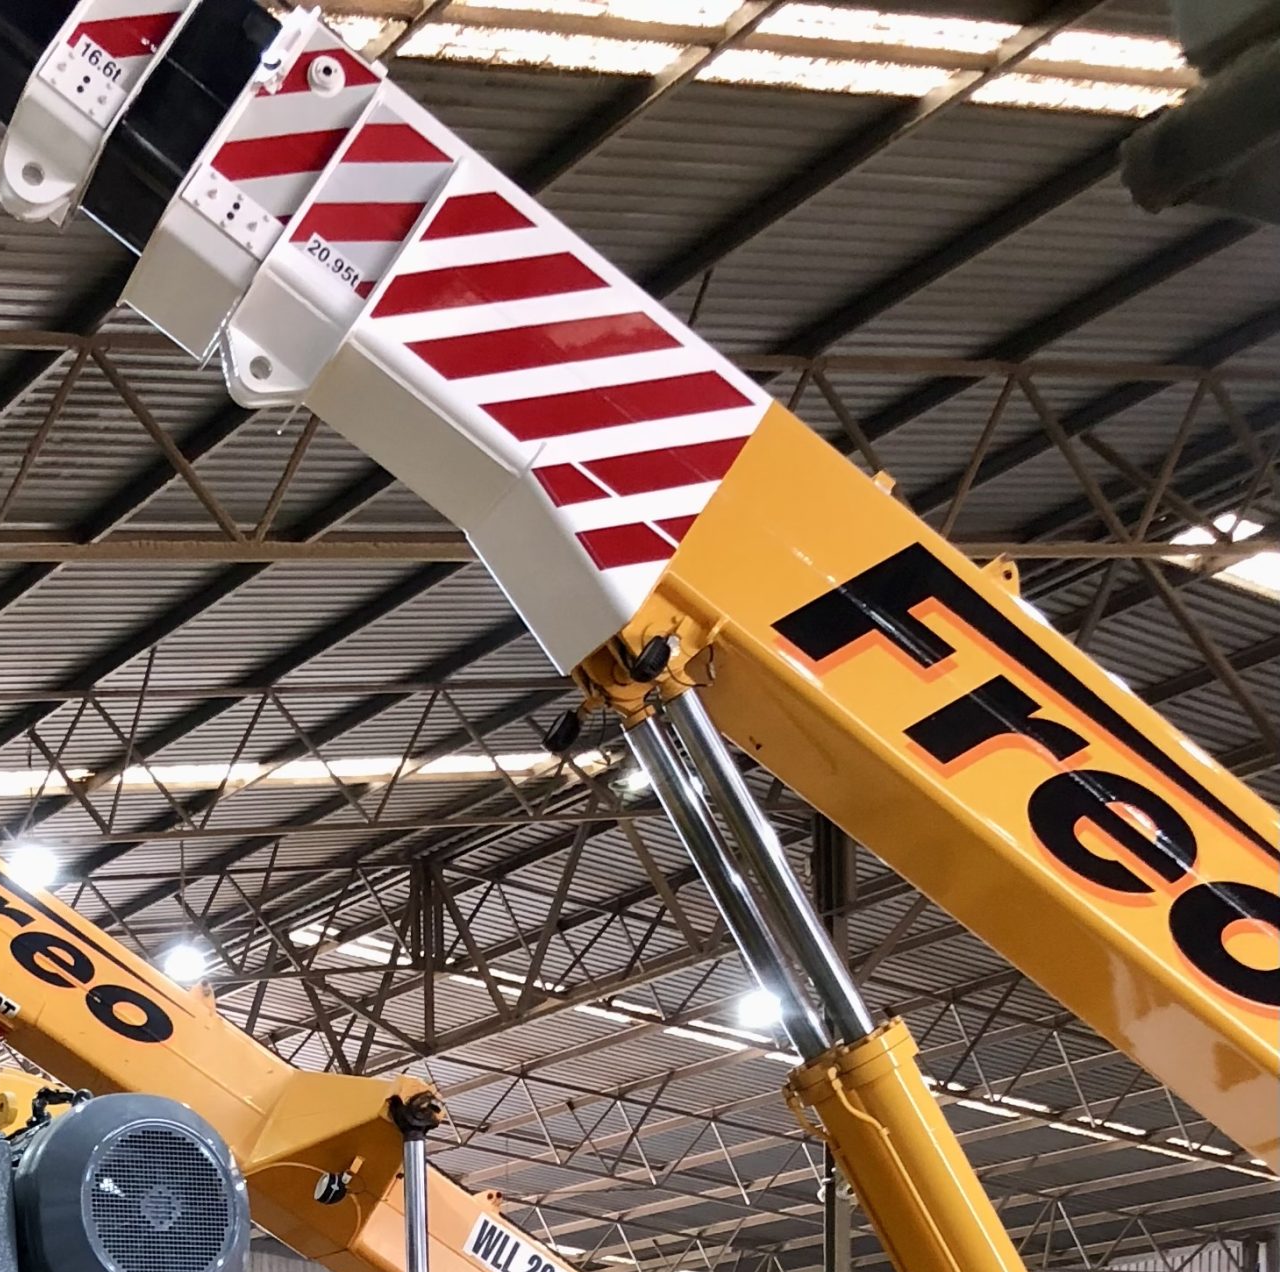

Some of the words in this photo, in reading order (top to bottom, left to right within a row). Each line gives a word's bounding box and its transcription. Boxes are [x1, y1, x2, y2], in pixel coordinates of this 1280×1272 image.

[81, 42, 122, 83] 16.6t
[307, 239, 359, 287] 20.95t
[770, 541, 1280, 1008] Freo
